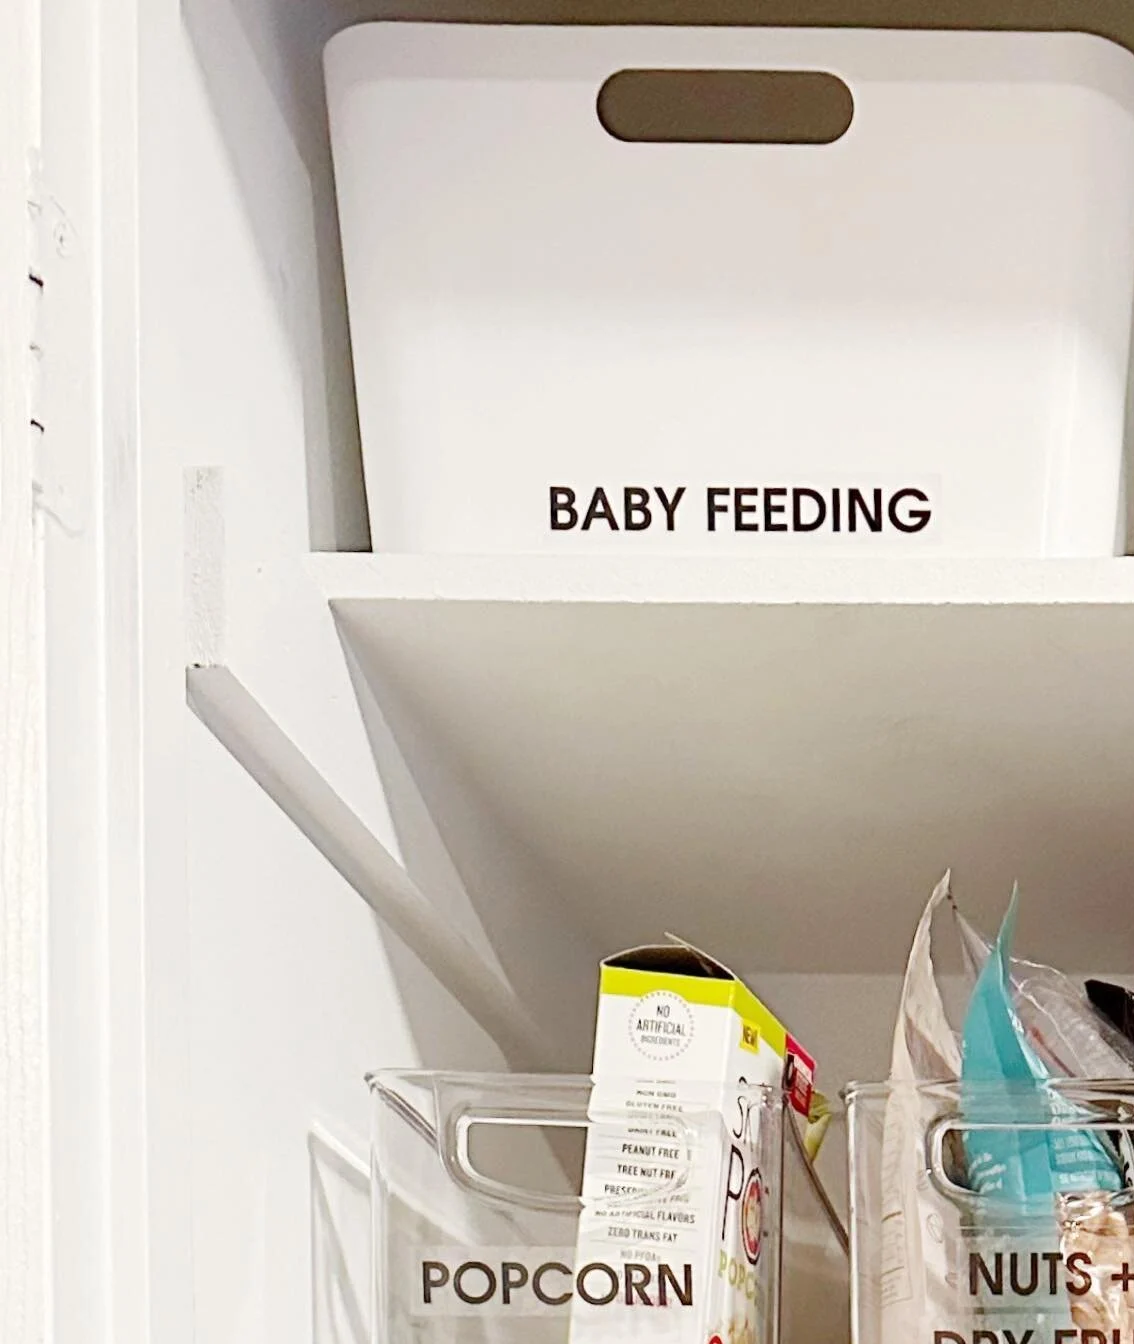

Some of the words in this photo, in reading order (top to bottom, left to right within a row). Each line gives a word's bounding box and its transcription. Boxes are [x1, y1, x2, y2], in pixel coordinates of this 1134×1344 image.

[550, 487, 687, 531] BABY
[707, 487, 932, 534] FEEDING
[656, 1005, 671, 1018] NO
[636, 1019, 686, 1037] ARTIFICIAL
[621, 1143, 657, 1159] PEANUT
[657, 1145, 680, 1160] FREE
[617, 1163, 639, 1177] TREE
[640, 1166, 658, 1179] NUT
[656, 1210, 696, 1225] FLAVORS
[631, 1228, 661, 1242] TRANS
[662, 1233, 678, 1244] FAT
[968, 1251, 1093, 1297] NUTS
[422, 1260, 695, 1307] POPCORN
